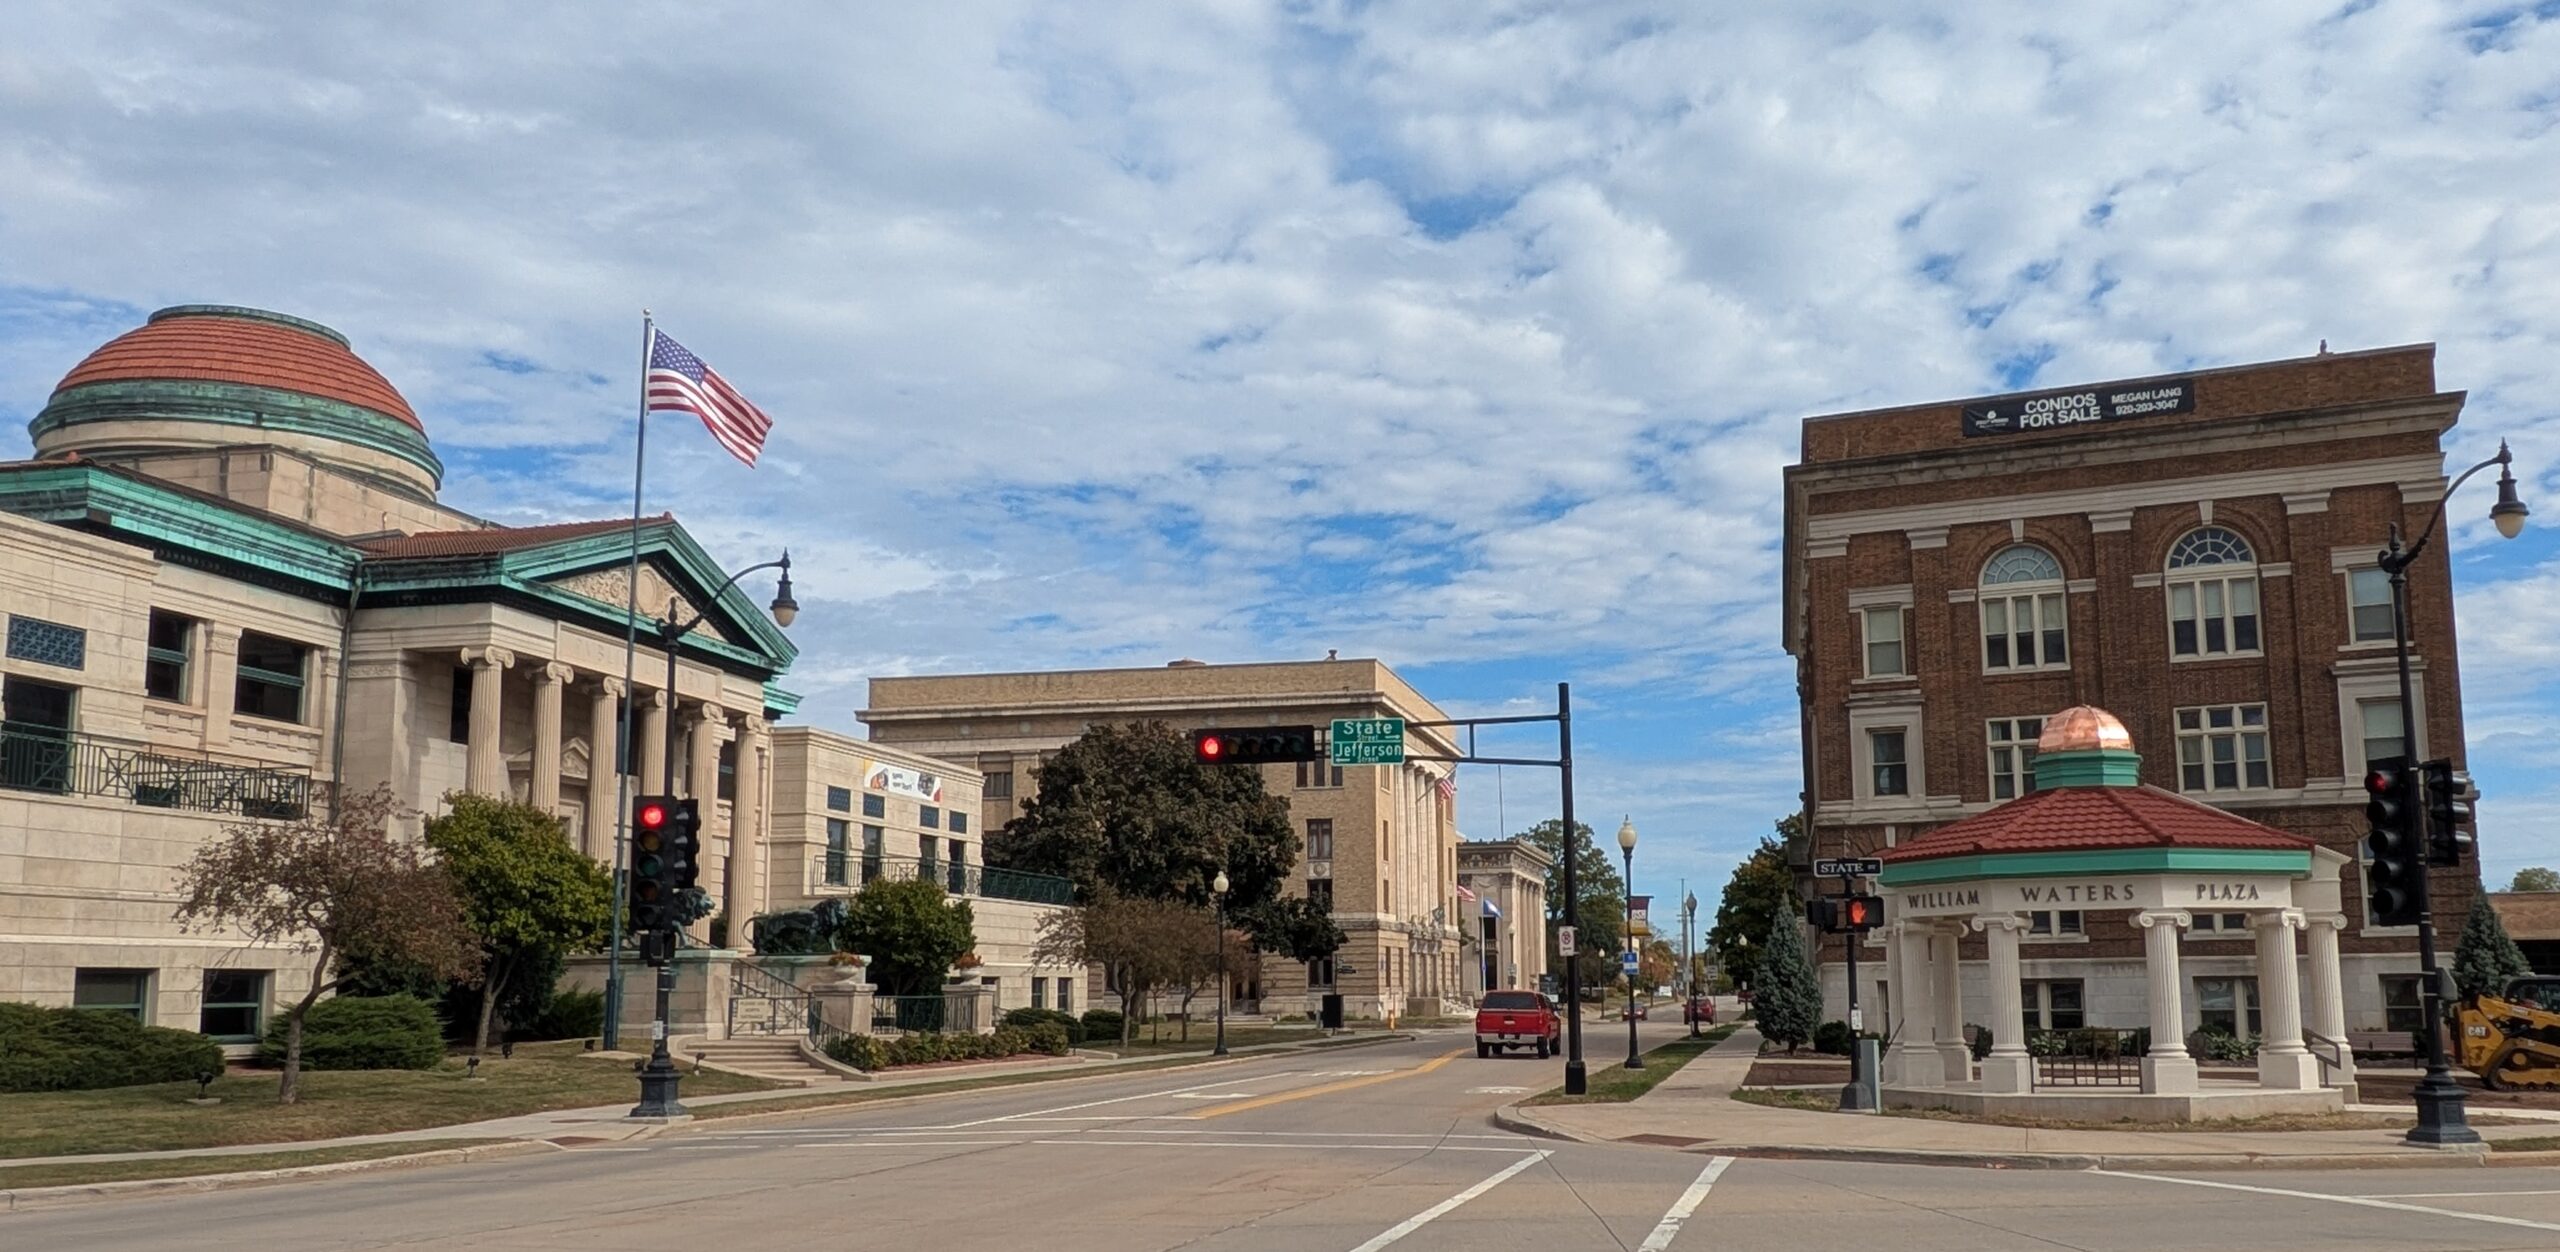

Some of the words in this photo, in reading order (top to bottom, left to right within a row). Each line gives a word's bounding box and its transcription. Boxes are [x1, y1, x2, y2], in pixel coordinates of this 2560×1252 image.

[2111, 390, 2150, 404] MEGAN
[2151, 386, 2183, 400] LANG
[2024, 392, 2097, 414] CONDOS
[2019, 411, 2055, 429] FOR
[2057, 405, 2102, 424] SALE
[1343, 720, 1393, 735] State
[1356, 734, 1379, 742] Street
[1335, 742, 1402, 758] Jefferson
[1356, 755, 1380, 763] Street
[1820, 862, 1865, 873] STATE
[1907, 889, 1980, 909] WILLIAM
[2020, 883, 2135, 903] WATERS
[2196, 883, 2260, 901] PLAZA
[2467, 1026, 2487, 1037] CAT
